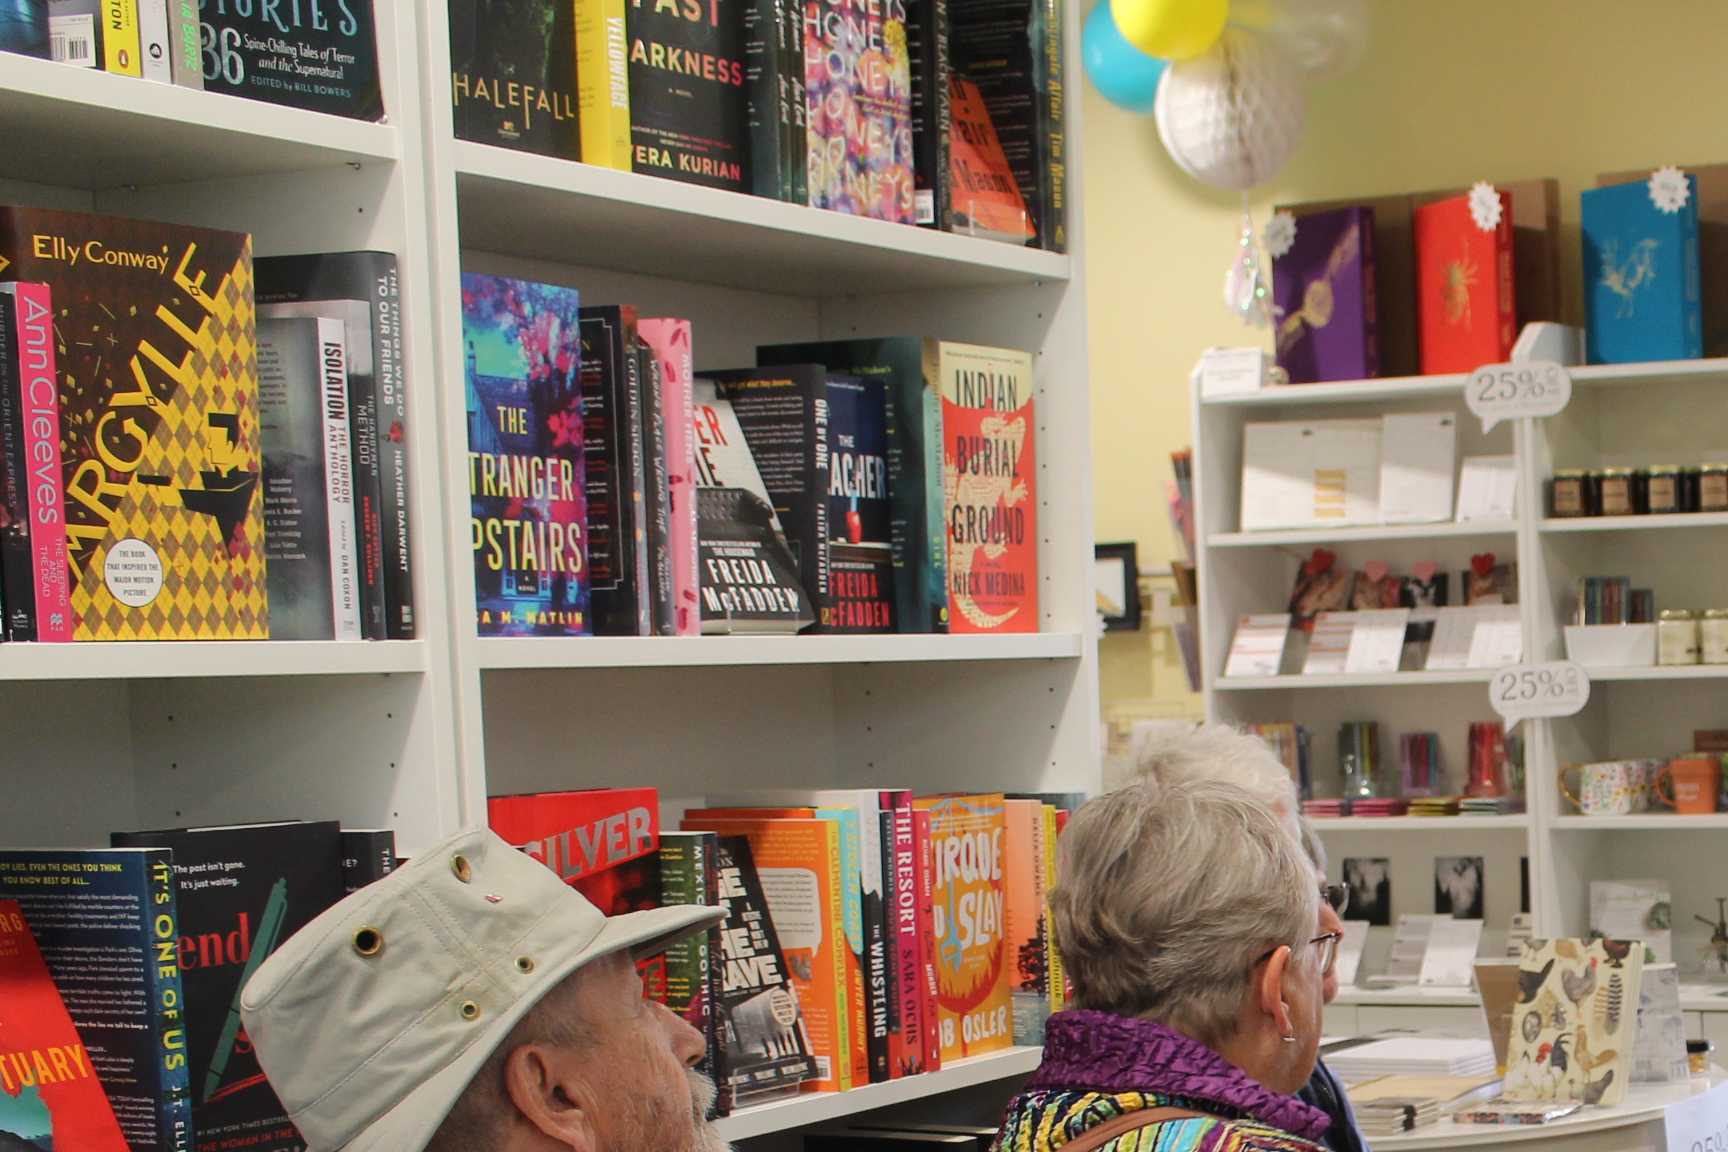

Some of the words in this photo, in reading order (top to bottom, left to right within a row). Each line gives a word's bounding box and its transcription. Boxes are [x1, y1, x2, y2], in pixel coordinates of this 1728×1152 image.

[243, 32, 298, 59] Spine-Chilling
[298, 42, 320, 62] Tales
[319, 44, 332, 65] of
[332, 47, 356, 65] Terror
[606, 17, 629, 110] YELLOWFACE
[258, 57, 280, 72] and
[280, 59, 294, 73] the
[294, 62, 345, 81] Supernatural
[251, 76, 282, 90] EDITED
[283, 82, 294, 92] by
[294, 82, 313, 94] BILL
[314, 85, 352, 99] BOWERS
[678, 152, 741, 181] KURIAN
[33, 234, 80, 266] Elly
[84, 240, 170, 274] Conway
[377, 276, 389, 297] TO
[390, 267, 398, 297] THE
[23, 296, 49, 370] Ann
[378, 301, 391, 335] OUR
[323, 341, 346, 421] ISOLATION
[381, 339, 395, 406] FRIENDS
[681, 353, 692, 419] MOTHER
[1477, 368, 1545, 402] 25%
[956, 369, 1018, 414] INDIAN
[496, 404, 528, 435] THE
[814, 398, 828, 426] ONE
[338, 426, 348, 450] THE
[356, 404, 371, 465] METHOD
[816, 429, 828, 442] BY
[838, 434, 855, 449] THE
[29, 376, 58, 525] Cleeves
[328, 425, 342, 503] ANTHOLOGY
[815, 443, 829, 470] ONE
[956, 435, 1019, 479] BURIAL
[339, 453, 351, 505] HORROR
[394, 450, 406, 507] HEATHER
[816, 503, 827, 539] FREIDA
[952, 503, 1025, 545] GROUND
[40, 545, 49, 563] THE
[55, 536, 63, 555] THE
[118, 549, 130, 559] THE
[130, 549, 146, 559] BOOK
[397, 510, 409, 573] DARWENT
[48, 560, 57, 583] AND
[106, 562, 121, 572] THAT
[120, 562, 148, 572] INSPIRED
[148, 563, 160, 572] THE
[113, 575, 133, 585] MAJOR
[133, 575, 155, 585] MOTION
[341, 555, 349, 575] DAN
[705, 558, 777, 585] FREIDA
[41, 567, 51, 598] DEAD
[56, 557, 67, 607] SLEEPING
[122, 588, 148, 597] PICTURE
[342, 577, 351, 611] COXON
[828, 571, 879, 599] FREIDA
[953, 571, 982, 597] NICK
[986, 571, 1026, 597] MEDINA
[701, 586, 800, 613] McFADDEN
[526, 611, 584, 625] MATLIN
[1500, 669, 1565, 701] 25%
[895, 802, 913, 846] THE
[12, 863, 27, 872] LIES.
[29, 863, 46, 872] EVEN
[47, 863, 61, 872] THE
[62, 863, 81, 872] ONES
[82, 863, 99, 873] YOU
[99, 863, 123, 873] THINK
[172, 865, 188, 874] The
[188, 863, 207, 876] past
[207, 862, 224, 871] isn't
[224, 859, 246, 872] gone.
[381, 847, 391, 875] THE
[2, 876, 18, 885] YOU
[19, 876, 41, 885] KNOW
[43, 876, 59, 885] BEST
[60, 876, 71, 885] OF
[151, 863, 171, 906] IT'S
[180, 880, 193, 889] It's
[193, 879, 210, 891] just
[209, 877, 240, 888] waiting.
[897, 851, 916, 937] RESORT
[154, 914, 178, 980] ONE
[177, 911, 250, 971] end
[872, 924, 881, 939] THE
[698, 944, 712, 1016] GOTHIC
[902, 949, 916, 995] SARA
[162, 989, 179, 1020] OF
[869, 941, 888, 1039] WHISTLING
[904, 999, 917, 1046] OCHS
[962, 1004, 1008, 1044] OSLER
[162, 1029, 186, 1071] US
[170, 1085, 184, 1115] J.T.
[196, 1141, 217, 1152] THE
[220, 1134, 259, 1149] WOMAN
[261, 1132, 273, 1143] IN
[273, 1128, 293, 1140] THE
